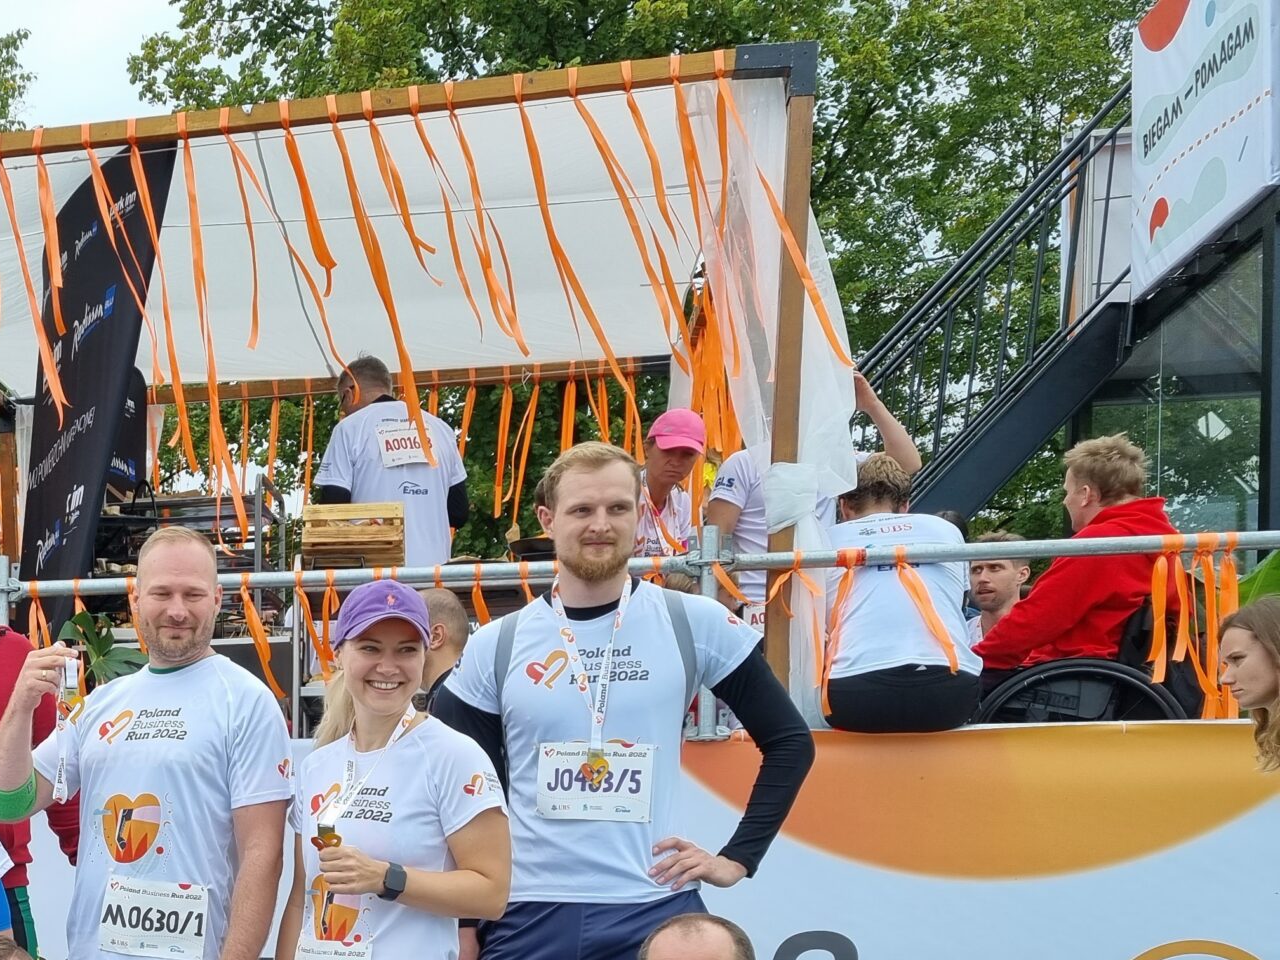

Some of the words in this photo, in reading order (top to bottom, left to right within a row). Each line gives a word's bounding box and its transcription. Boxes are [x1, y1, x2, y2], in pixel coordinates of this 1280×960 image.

[1143, 96, 1183, 159] BIEGAM
[1195, 17, 1255, 98] POMAGAM
[71, 301, 105, 362] Radisson
[715, 477, 735, 488] GLS
[403, 487, 419, 496] Enea
[880, 523, 913, 534] UBS
[582, 659, 642, 672] usness
[609, 670, 650, 682] 2022
[597, 683, 608, 714] Poland
[137, 707, 182, 720] Poland
[131, 718, 185, 731] Business
[125, 731, 150, 741] Run
[152, 728, 187, 741] 2022
[612, 750, 627, 758] Run
[546, 767, 642, 795] J043/5
[356, 786, 389, 797] land
[351, 796, 391, 810] siness
[354, 808, 393, 823] 2022
[119, 884, 141, 894] Poland
[141, 889, 171, 898] Business
[185, 893, 203, 901] 2022
[101, 903, 204, 937] M0630/1
[347, 950, 366, 958] 2022
